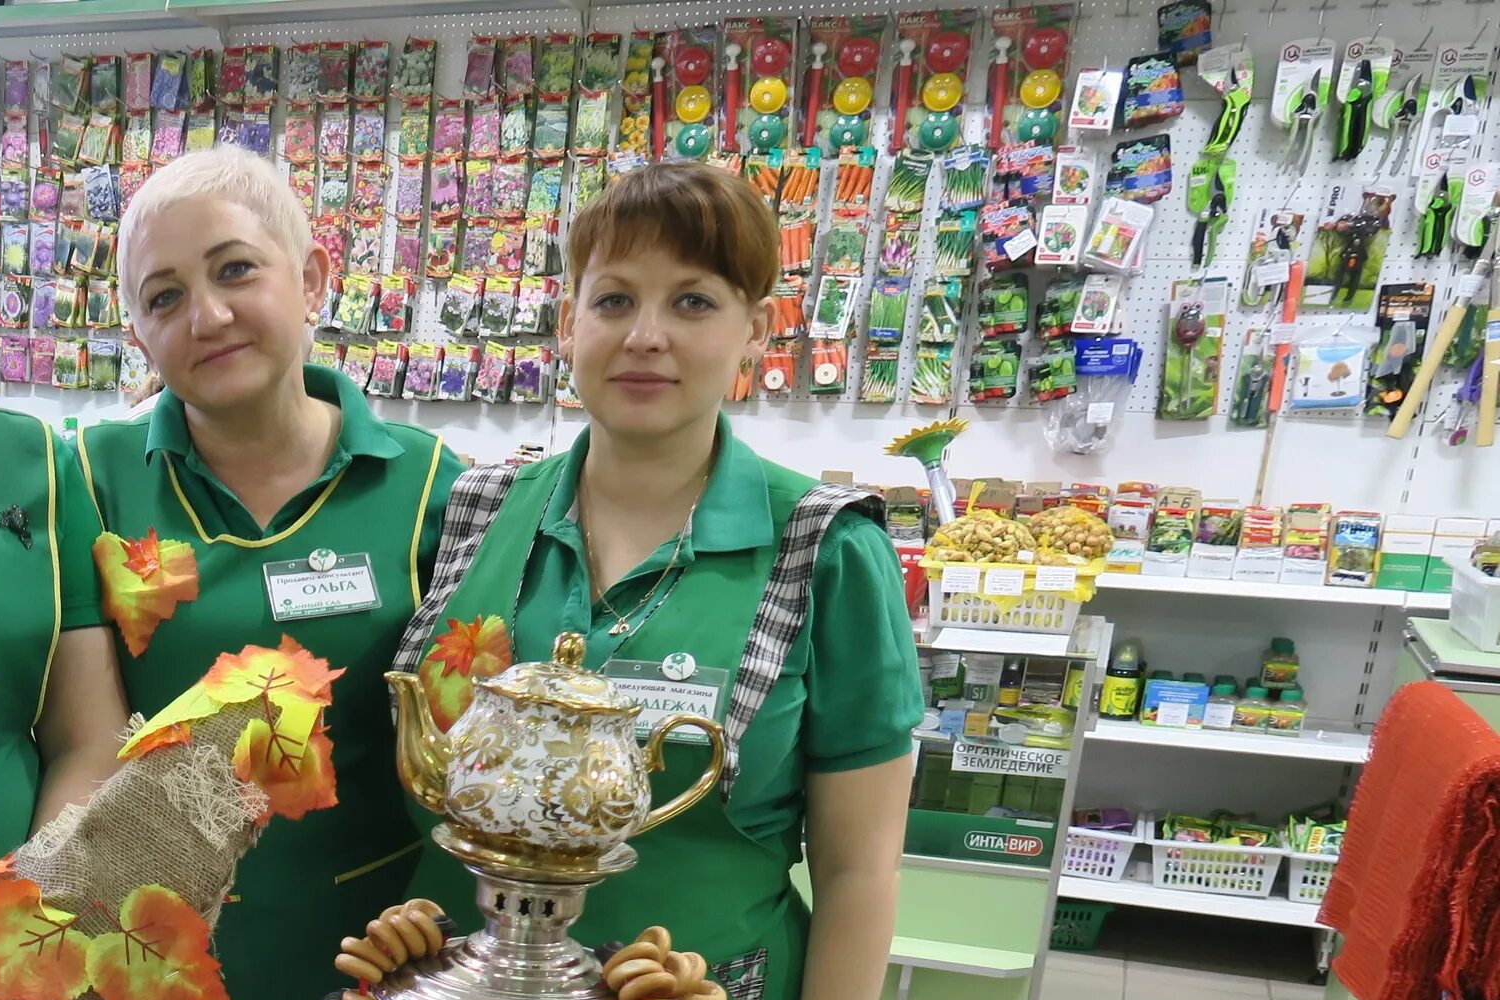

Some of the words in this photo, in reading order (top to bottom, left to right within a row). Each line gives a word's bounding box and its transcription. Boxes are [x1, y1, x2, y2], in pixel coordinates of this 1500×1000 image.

[1329, 185, 1341, 206] PRO
[302, 580, 357, 595] ОЛЬГА
[613, 682, 666, 692] Заведующая
[669, 687, 713, 698] магазина
[972, 686, 984, 698] Si
[956, 743, 1063, 765] ОРГАНИЧЕСКОЕ
[961, 756, 1054, 774] ЗЕМЛЕДЕЛИЕ
[968, 833, 1037, 851] ИНТА-ВИР
